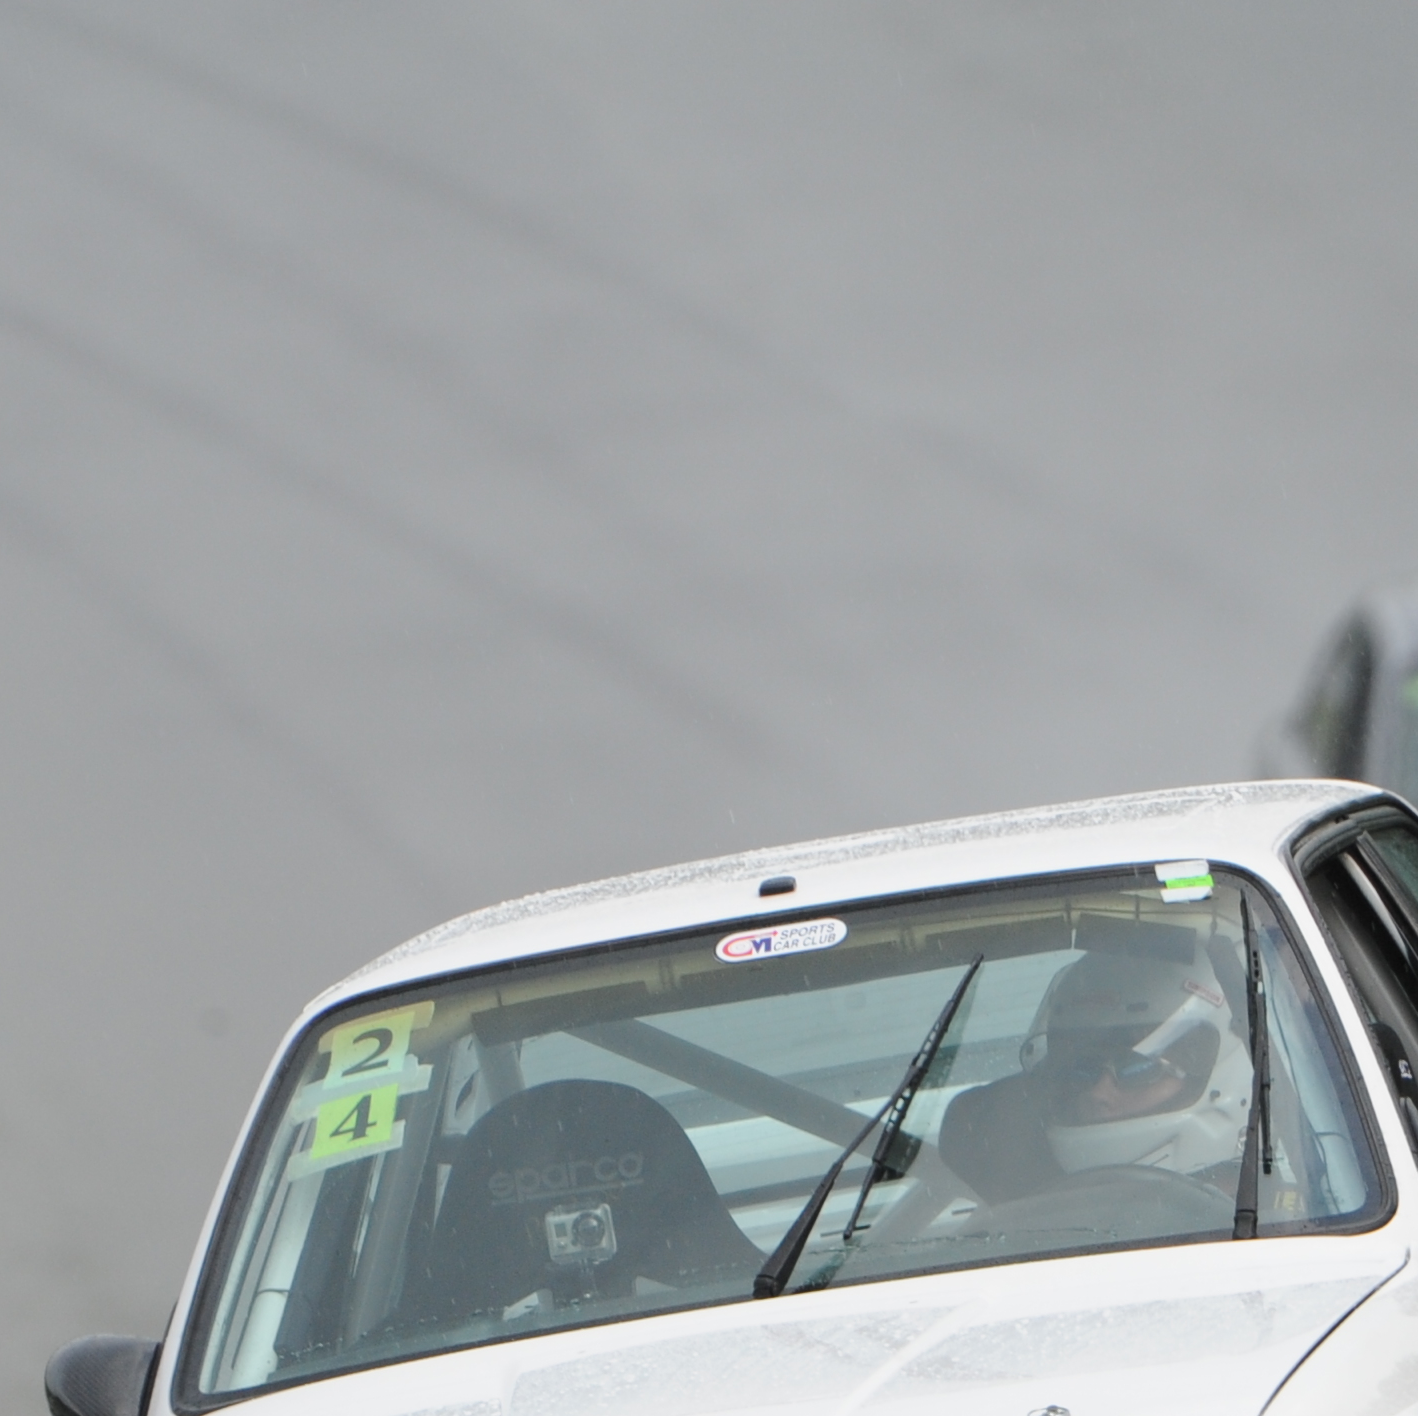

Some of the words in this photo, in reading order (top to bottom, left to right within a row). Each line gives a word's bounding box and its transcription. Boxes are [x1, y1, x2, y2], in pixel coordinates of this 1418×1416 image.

[773, 938, 799, 951] CAR
[802, 932, 836, 947] CLUB
[780, 922, 835, 940] SPORTS
[341, 1027, 393, 1077] 2
[329, 1094, 377, 1142] 4
[488, 1152, 644, 1203] sparco
